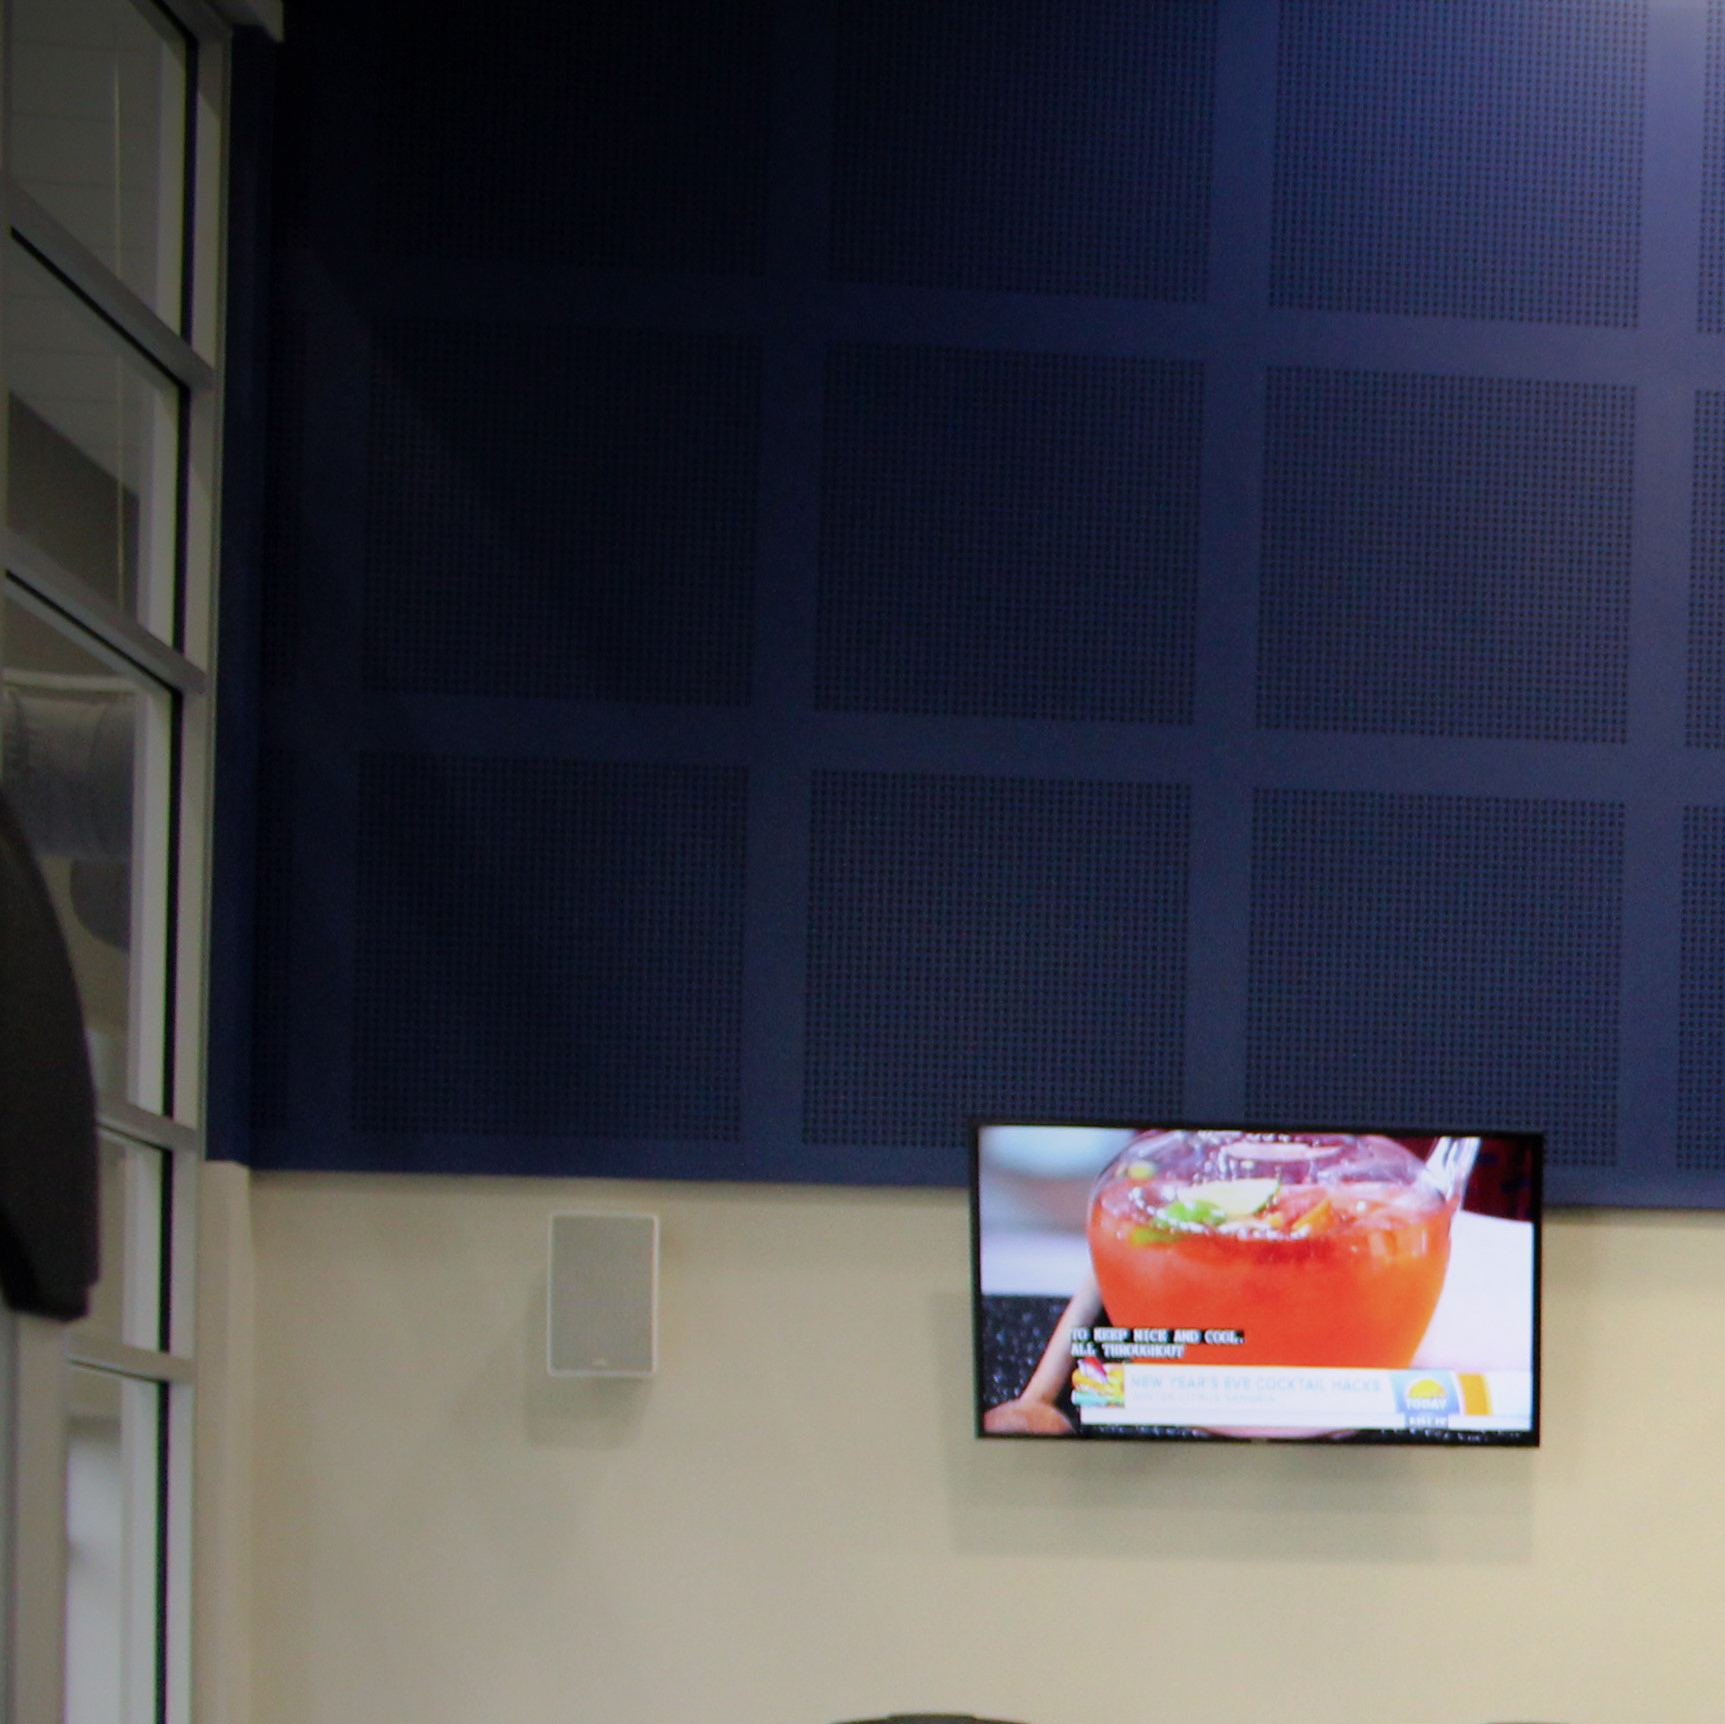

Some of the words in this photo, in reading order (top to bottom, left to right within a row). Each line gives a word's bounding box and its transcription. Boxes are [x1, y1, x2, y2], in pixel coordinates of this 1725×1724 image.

[1093, 1327, 1128, 1343] KEEP
[1173, 1329, 1201, 1344] AND
[1071, 1342, 1097, 1357] ALL
[1256, 1376, 1326, 1392] COCKTAIL
[1332, 1377, 1381, 1393] HACKS
